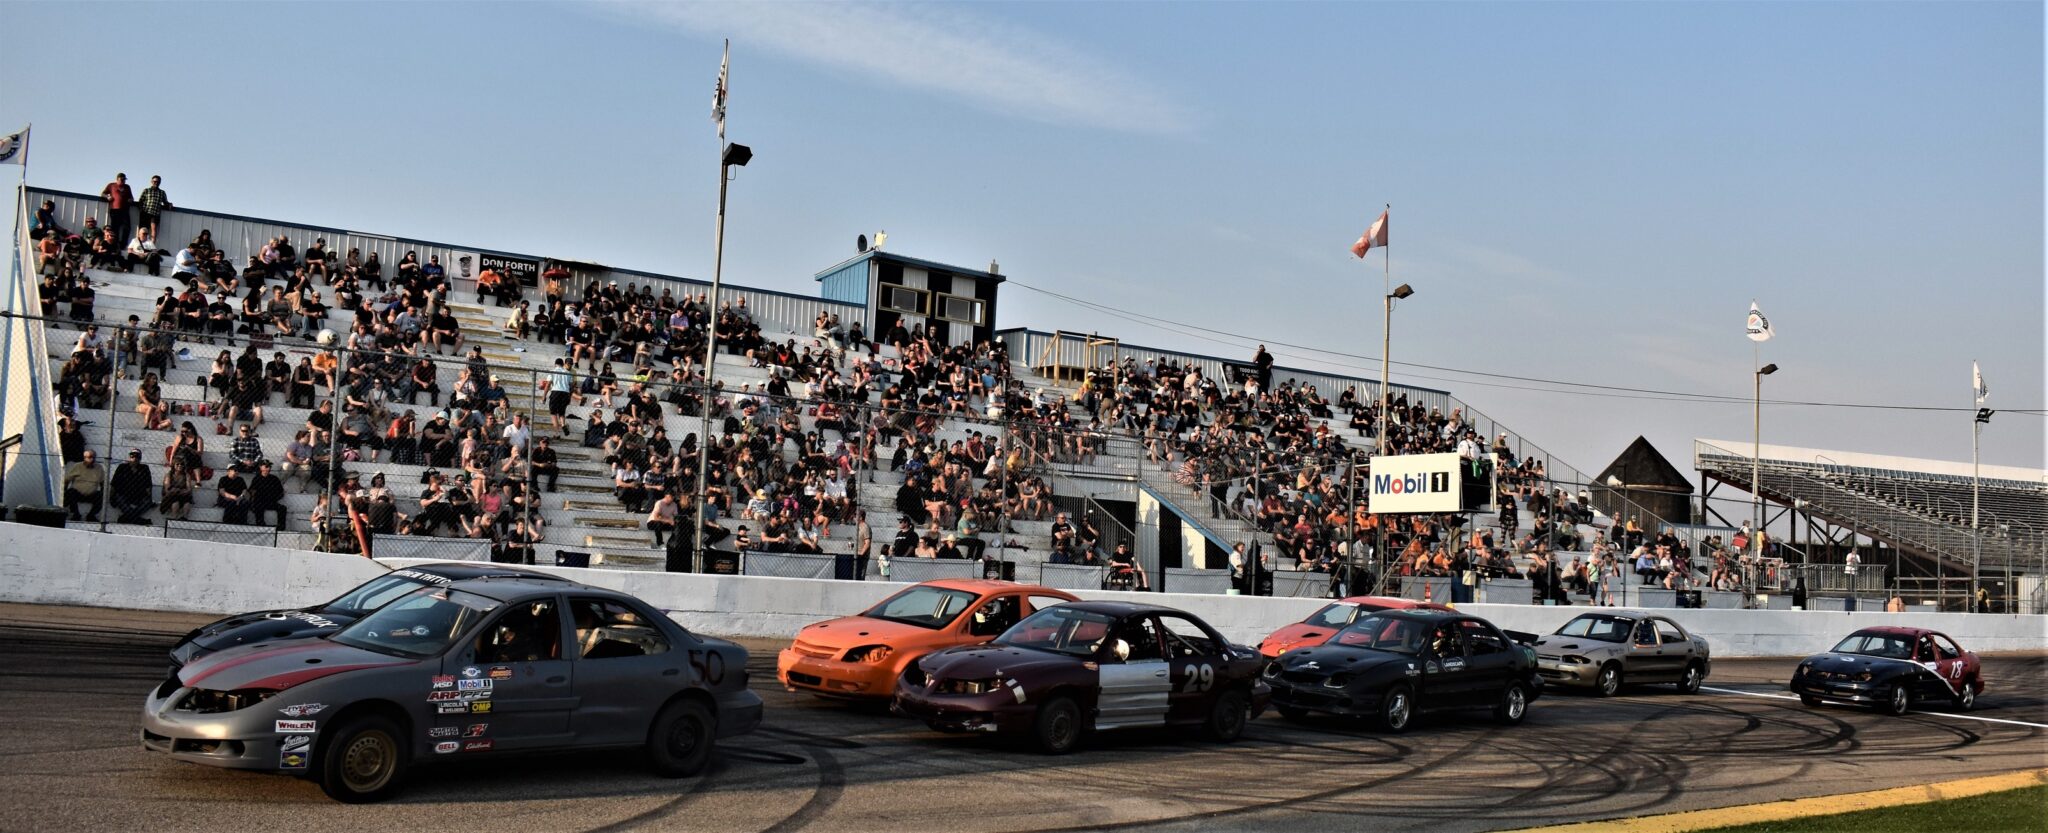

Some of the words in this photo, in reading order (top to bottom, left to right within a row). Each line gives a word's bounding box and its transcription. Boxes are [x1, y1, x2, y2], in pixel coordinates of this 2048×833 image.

[483, 258, 504, 268] DON
[505, 261, 535, 272] FORTH
[1375, 472, 1427, 494] Mobil
[1433, 472, 1446, 492] 1
[687, 649, 725, 687] 50
[1950, 660, 1963, 679] 18
[460, 680, 481, 689] Mobil
[1182, 663, 1214, 694] 29
[429, 692, 460, 700] ARP
[472, 703, 491, 711] OMP
[438, 743, 456, 751] BELL
